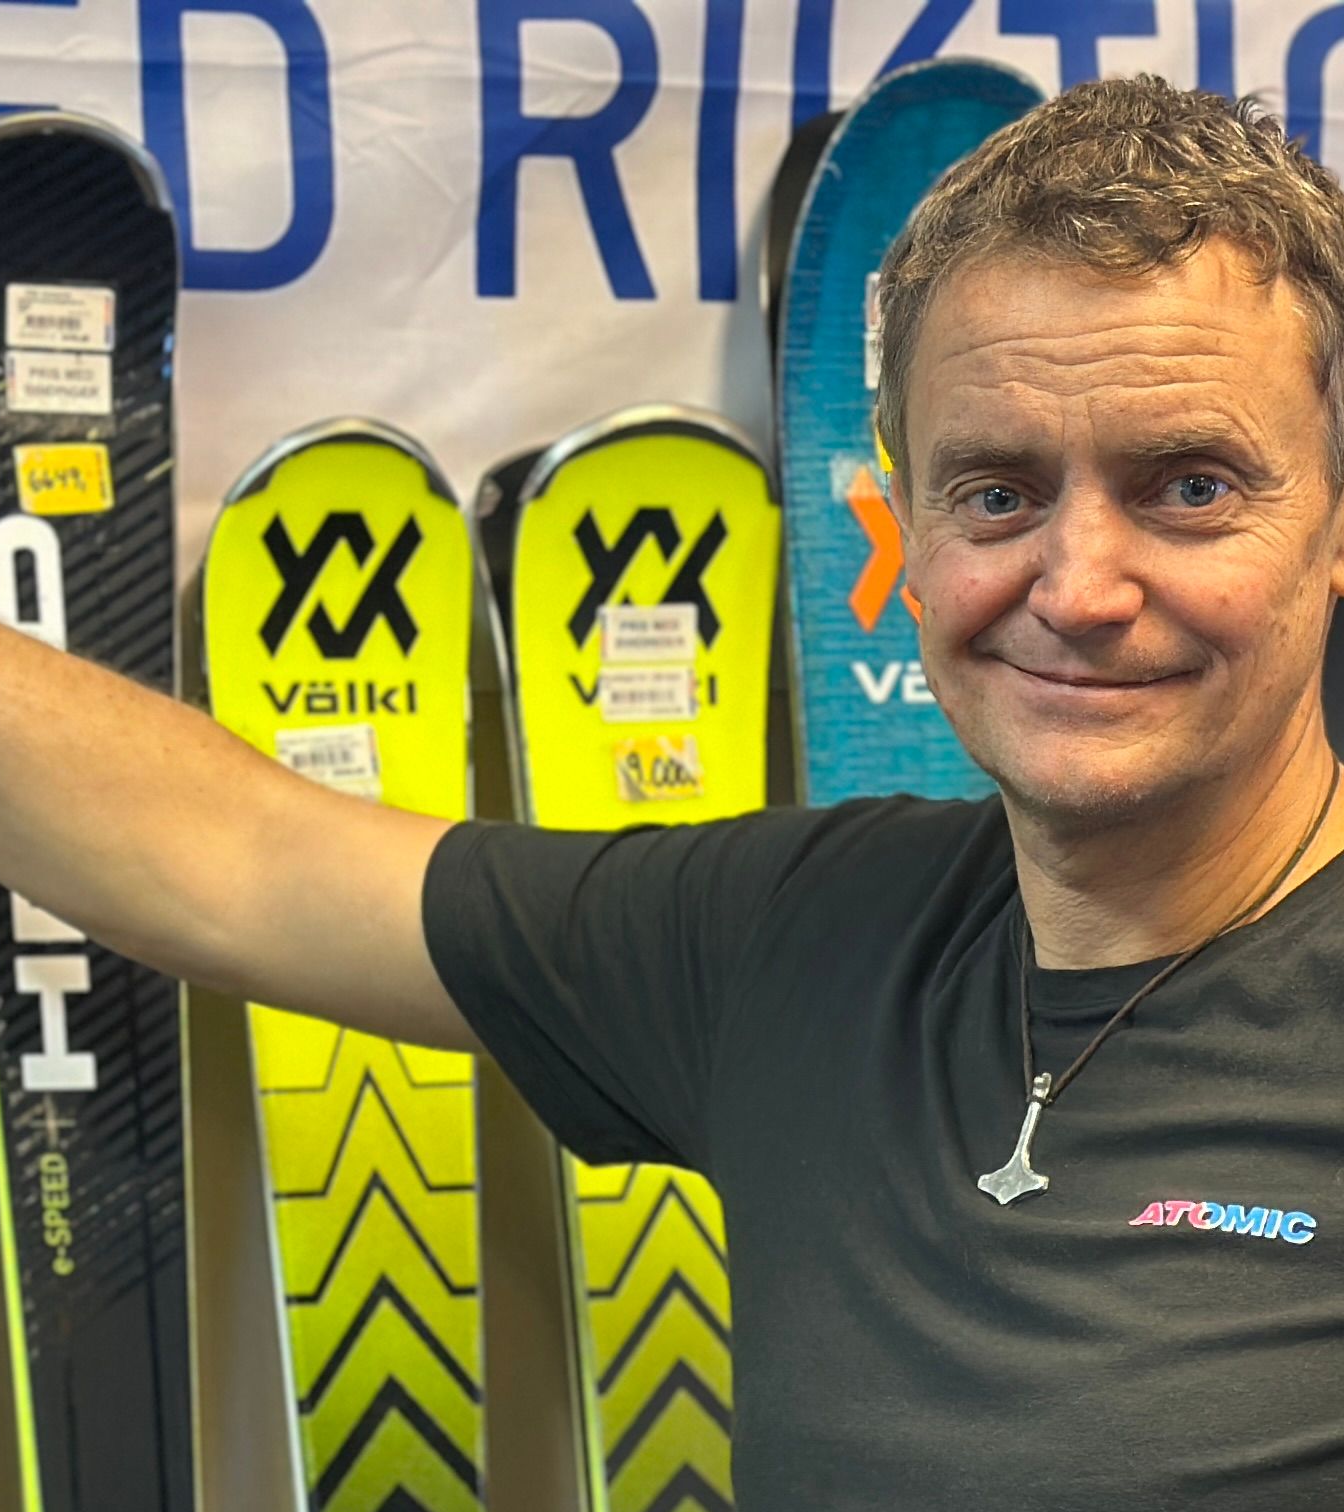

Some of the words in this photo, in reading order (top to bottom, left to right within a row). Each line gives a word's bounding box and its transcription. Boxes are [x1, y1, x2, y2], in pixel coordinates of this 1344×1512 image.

[260, 681, 418, 714] Völkl
[35, 1152, 73, 1276] e-SPEED
[1128, 1200, 1317, 1244] ATOMIC
